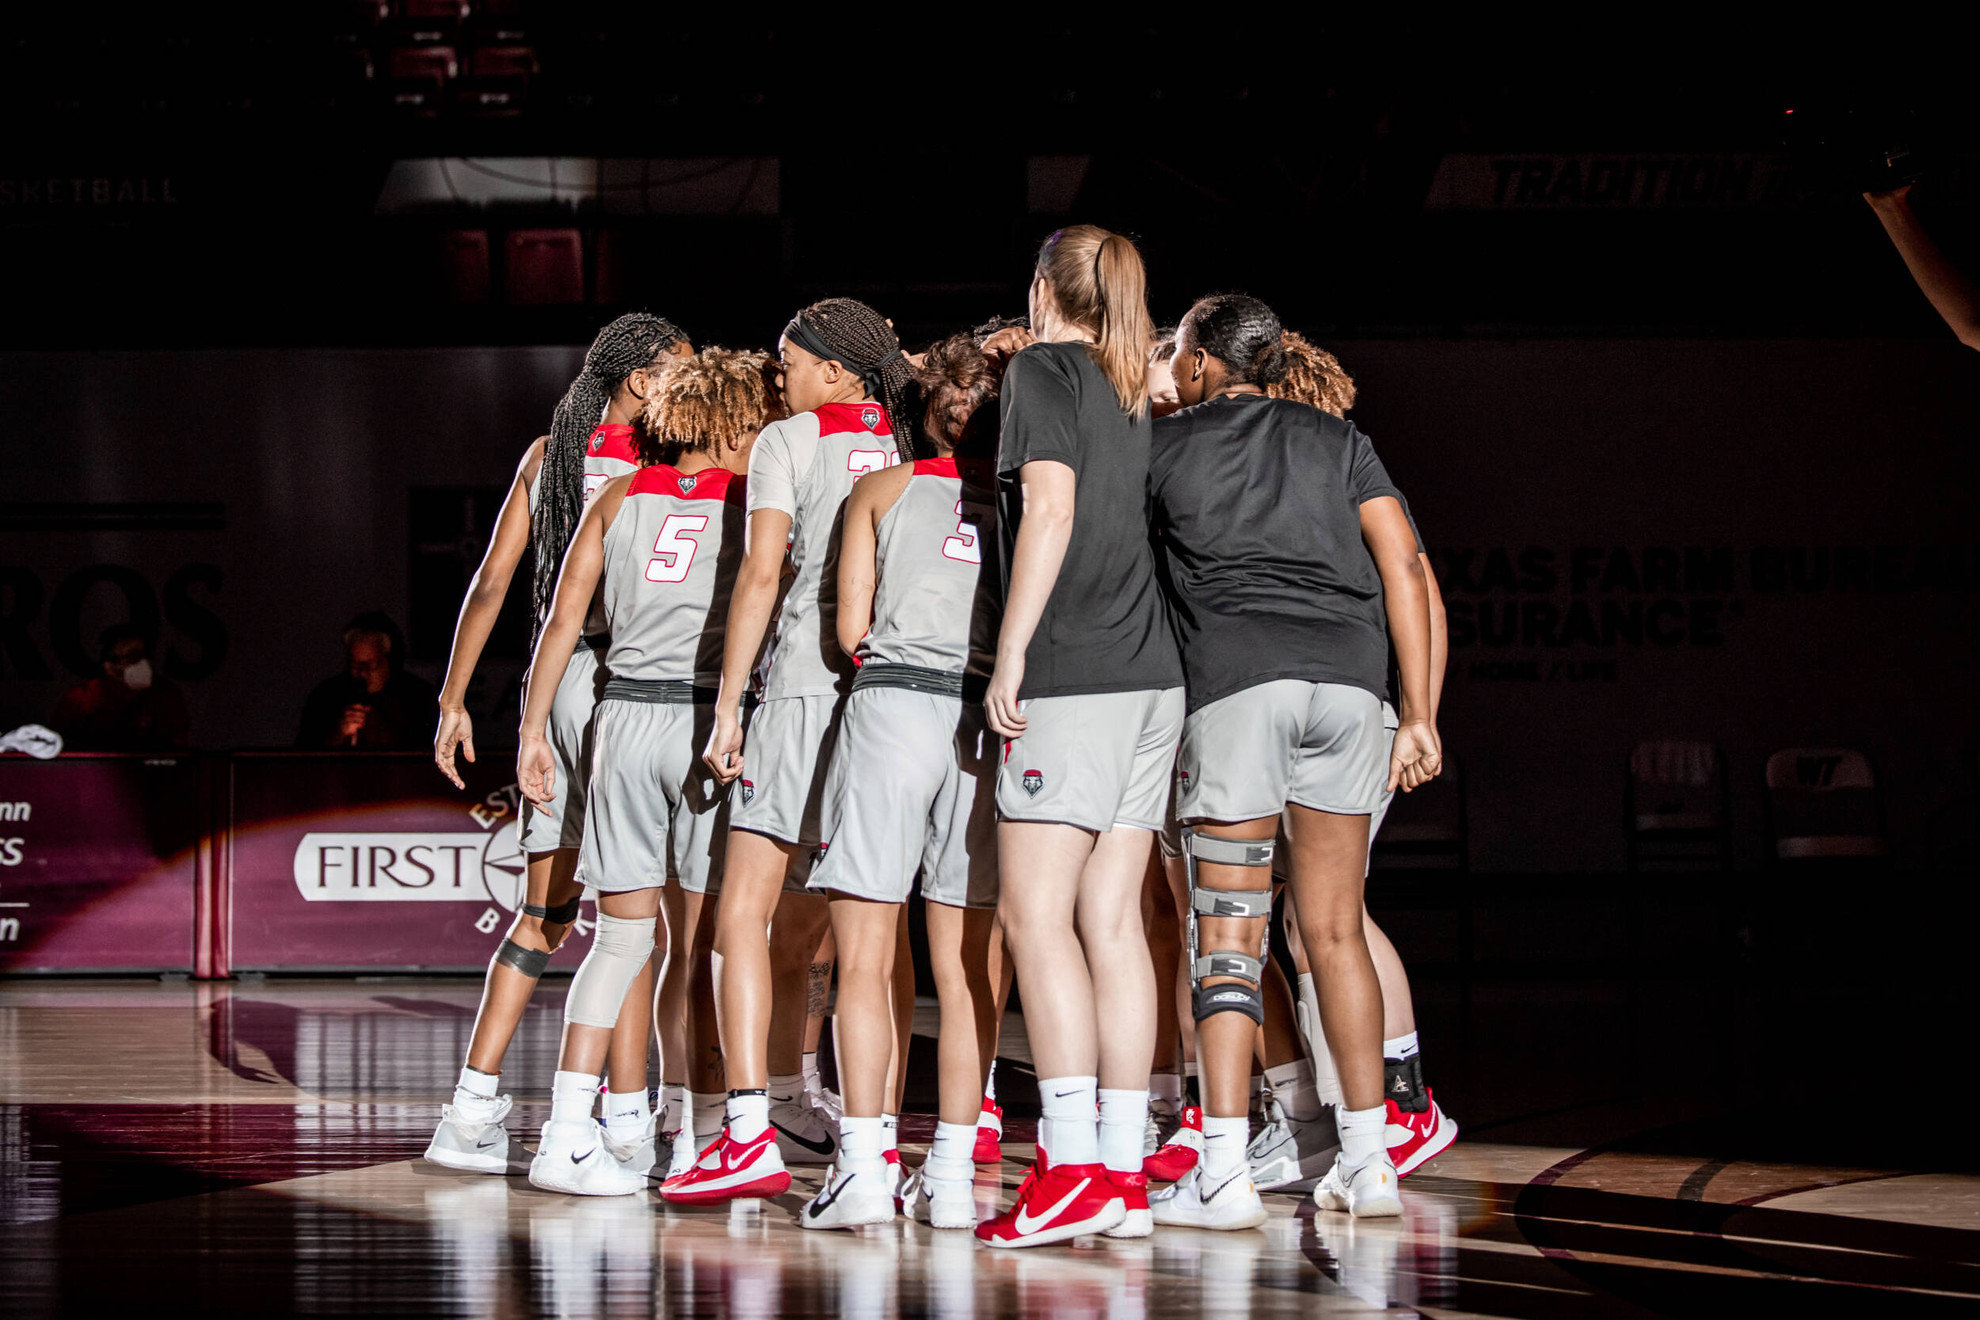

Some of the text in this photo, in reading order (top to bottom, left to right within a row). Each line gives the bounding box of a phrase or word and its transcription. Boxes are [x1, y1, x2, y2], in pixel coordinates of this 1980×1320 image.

[1490, 159, 1754, 203] TRADITION
[645, 514, 708, 583] 5
[1430, 546, 1557, 592] XAS
[1572, 546, 1734, 592] FARM
[318, 845, 477, 888] FIRST
